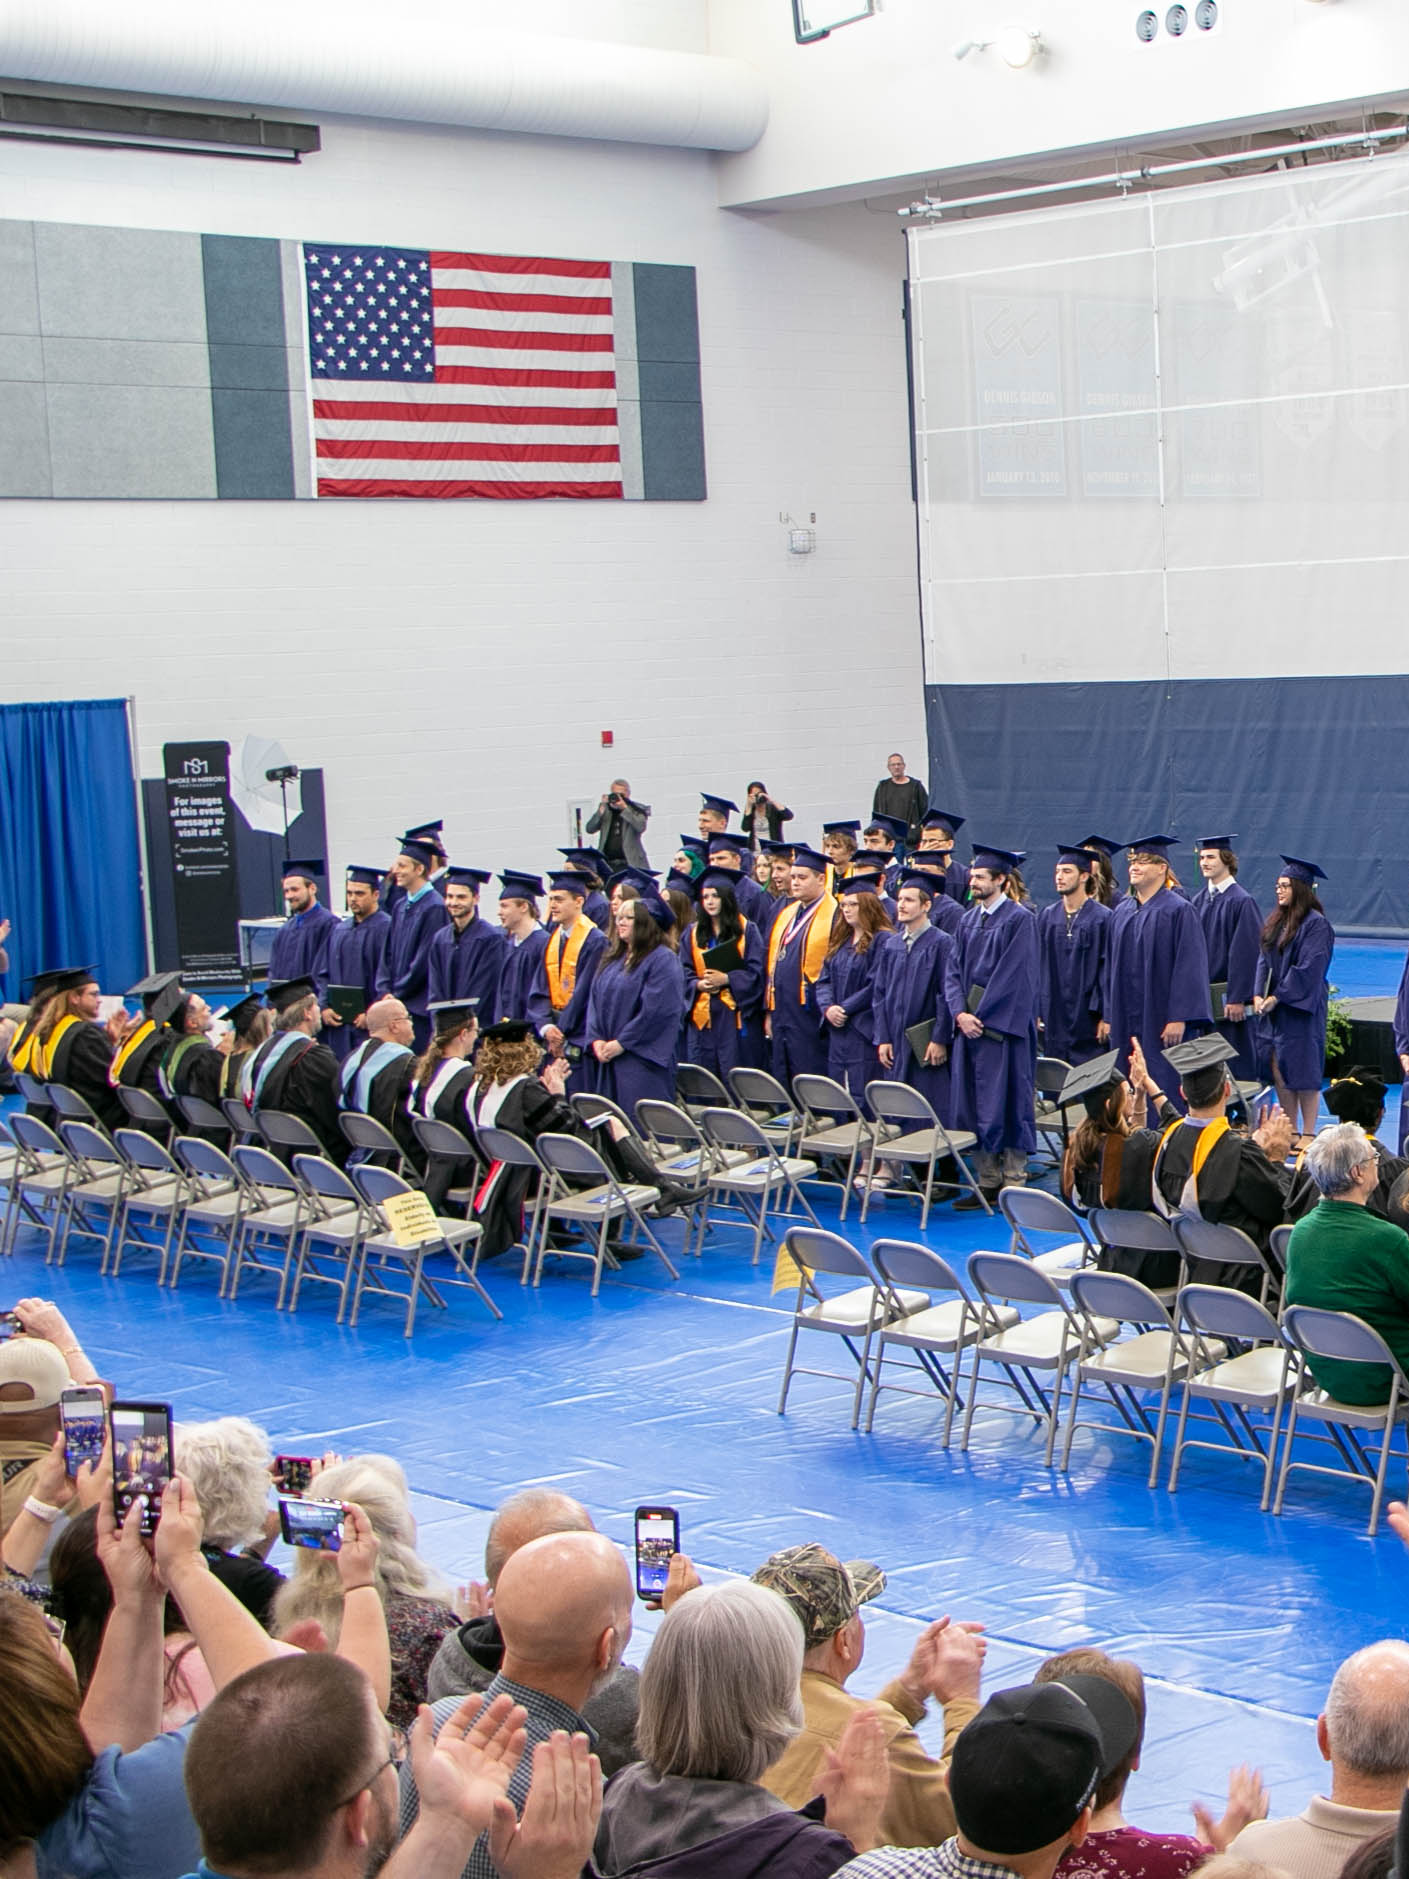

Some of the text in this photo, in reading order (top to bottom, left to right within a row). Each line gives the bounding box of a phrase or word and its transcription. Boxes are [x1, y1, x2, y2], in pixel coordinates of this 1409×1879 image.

[174, 796, 222, 807] For images
[170, 806, 226, 817] of this event,
[174, 818, 224, 828] message or
[178, 828, 197, 837] visit
[199, 829, 209, 837] us
